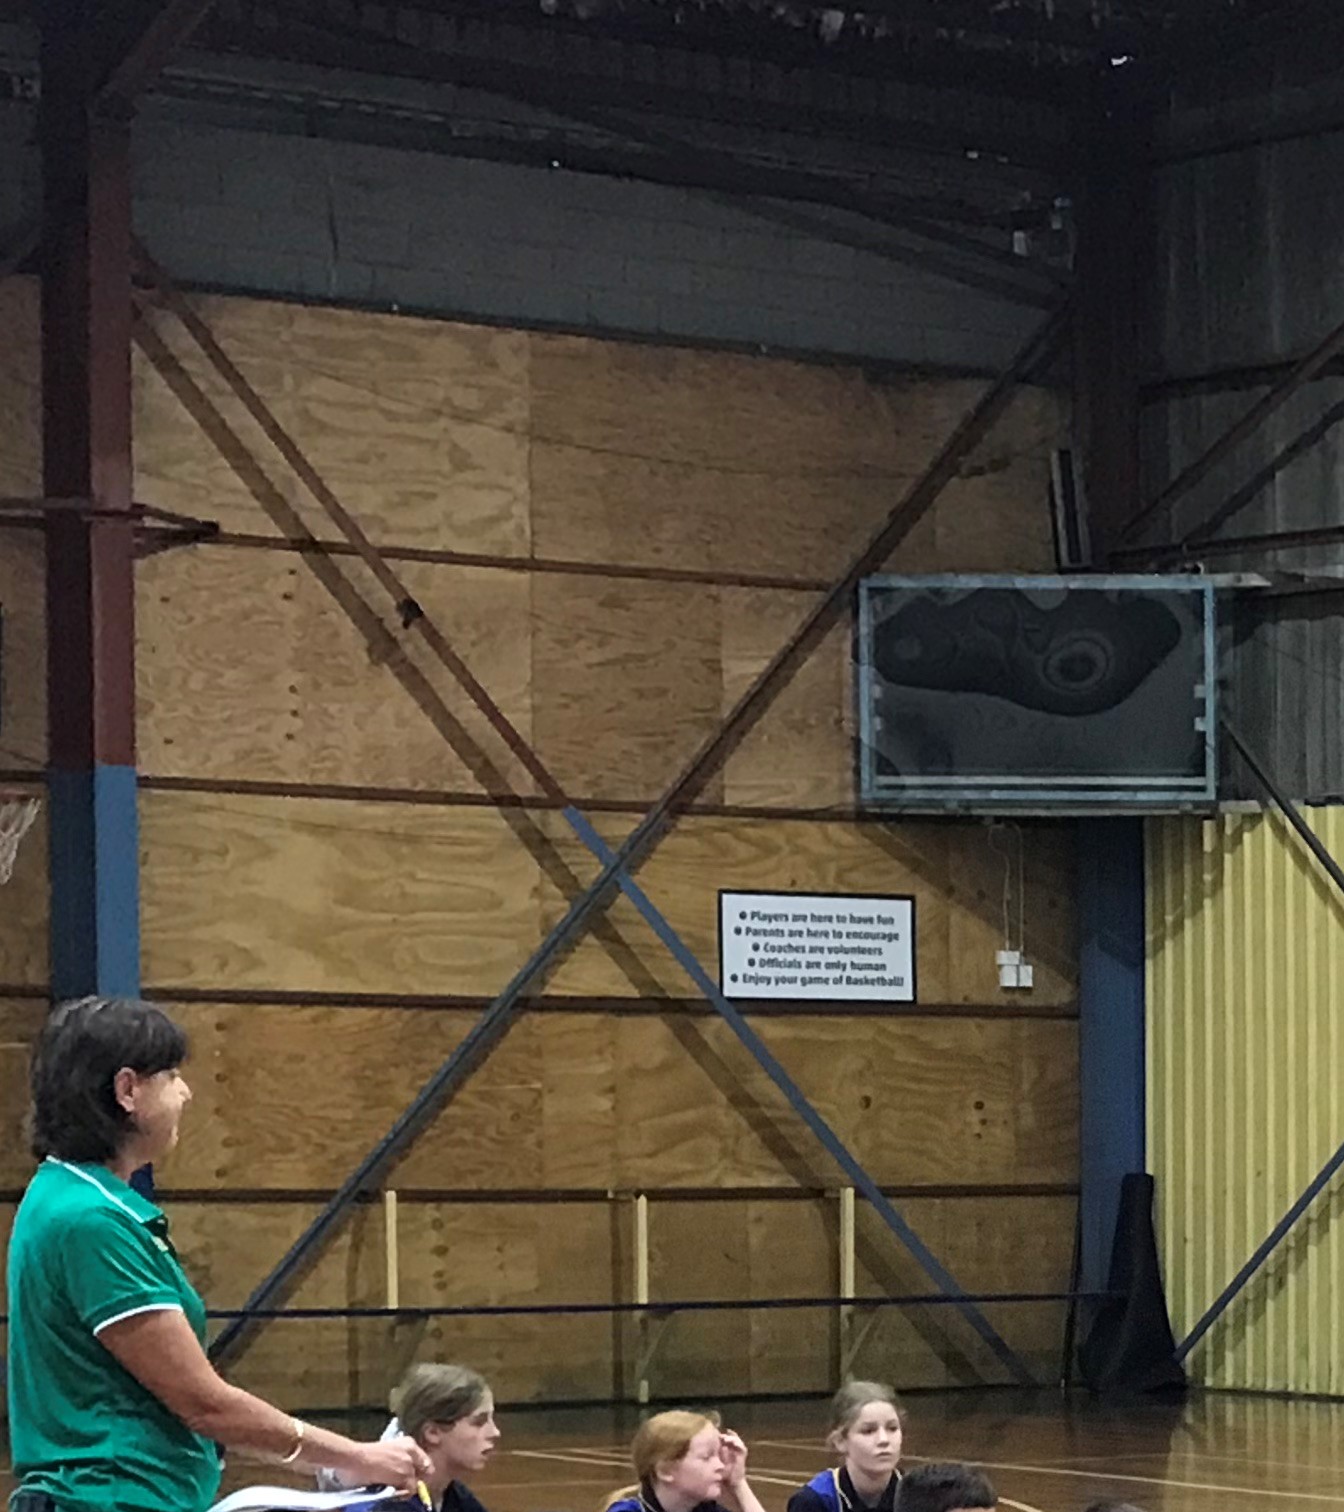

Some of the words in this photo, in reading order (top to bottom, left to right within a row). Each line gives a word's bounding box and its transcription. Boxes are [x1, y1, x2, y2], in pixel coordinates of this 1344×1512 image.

[750, 910, 789, 924] Players
[791, 913, 808, 923] are
[810, 912, 833, 923] here
[836, 913, 847, 924] to
[849, 913, 874, 925] have
[876, 914, 895, 925] fun
[745, 926, 785, 938] Parents
[788, 929, 804, 938] are
[806, 927, 830, 939] here
[832, 929, 843, 940] to
[845, 931, 899, 943] encourage
[763, 942, 806, 954] Coaches
[808, 945, 825, 955] are
[826, 944, 884, 956] volunteers
[758, 957, 802, 969] Officials
[805, 960, 821, 970] are
[824, 960, 847, 972] only
[850, 960, 887, 971] human
[742, 972, 772, 986] Enjoy
[774, 975, 798, 986] your
[800, 976, 830, 987] game
[832, 975, 843, 986] of
